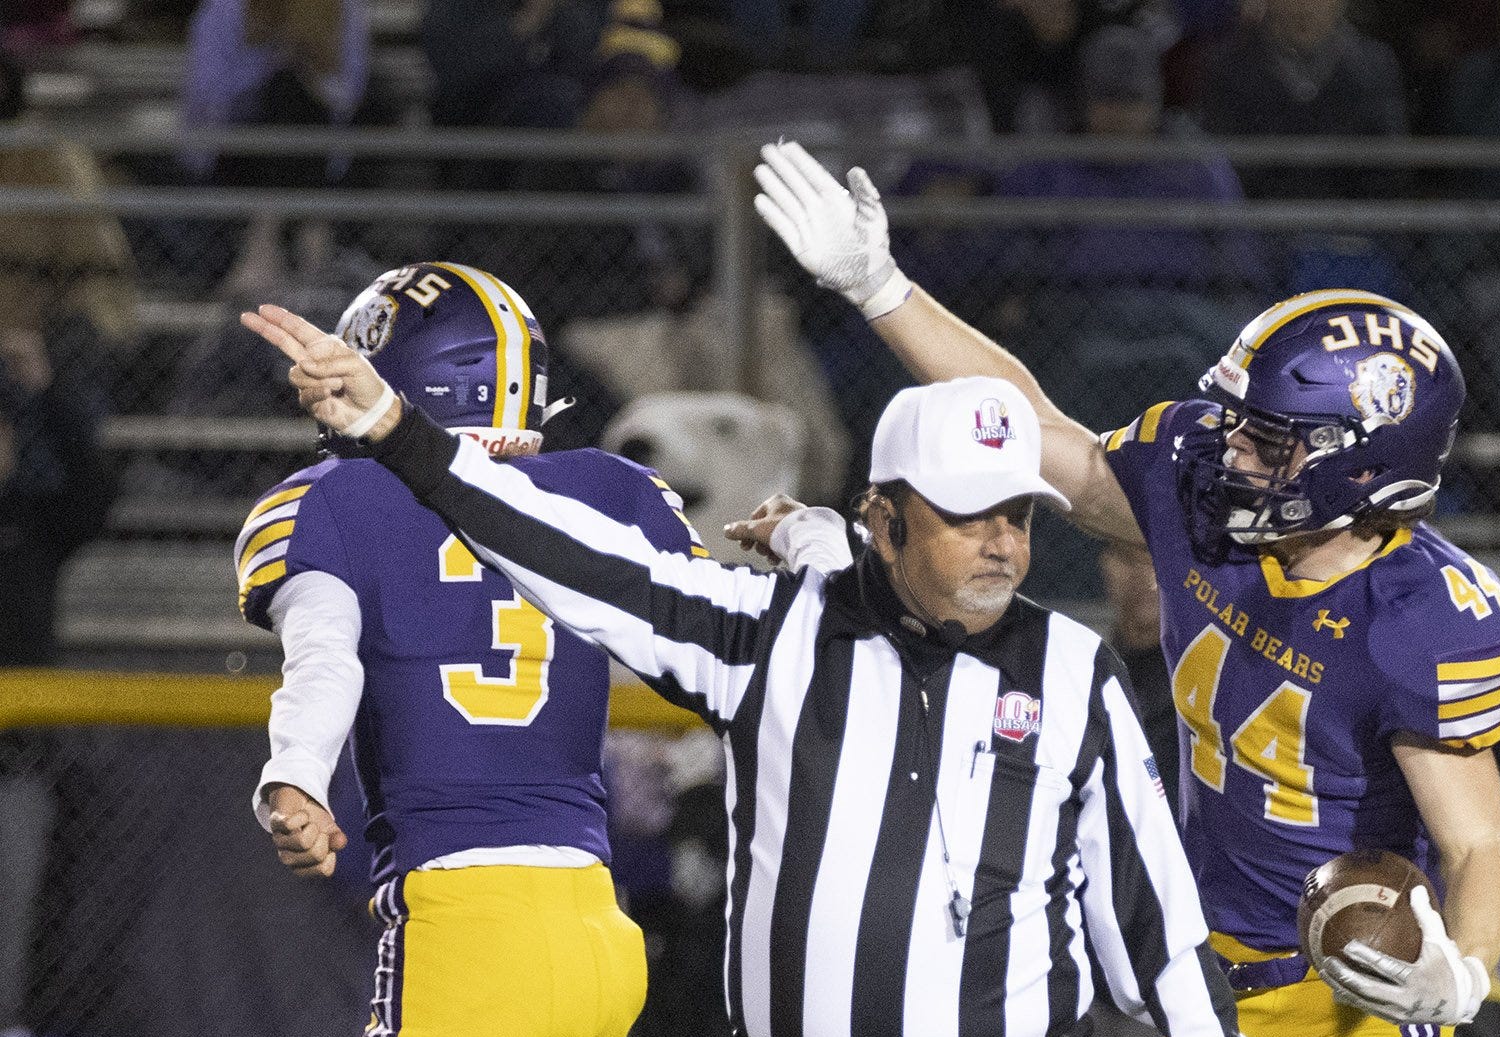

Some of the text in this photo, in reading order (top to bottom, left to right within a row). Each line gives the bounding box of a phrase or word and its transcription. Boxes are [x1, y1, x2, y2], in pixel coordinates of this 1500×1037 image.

[1321, 313, 1441, 374] JHS
[477, 385, 489, 402] 3
[971, 426, 1016, 441] OHSAA
[438, 530, 555, 727] 3
[1183, 568, 1325, 684] POLAR BEARS
[1171, 622, 1320, 828] 44
